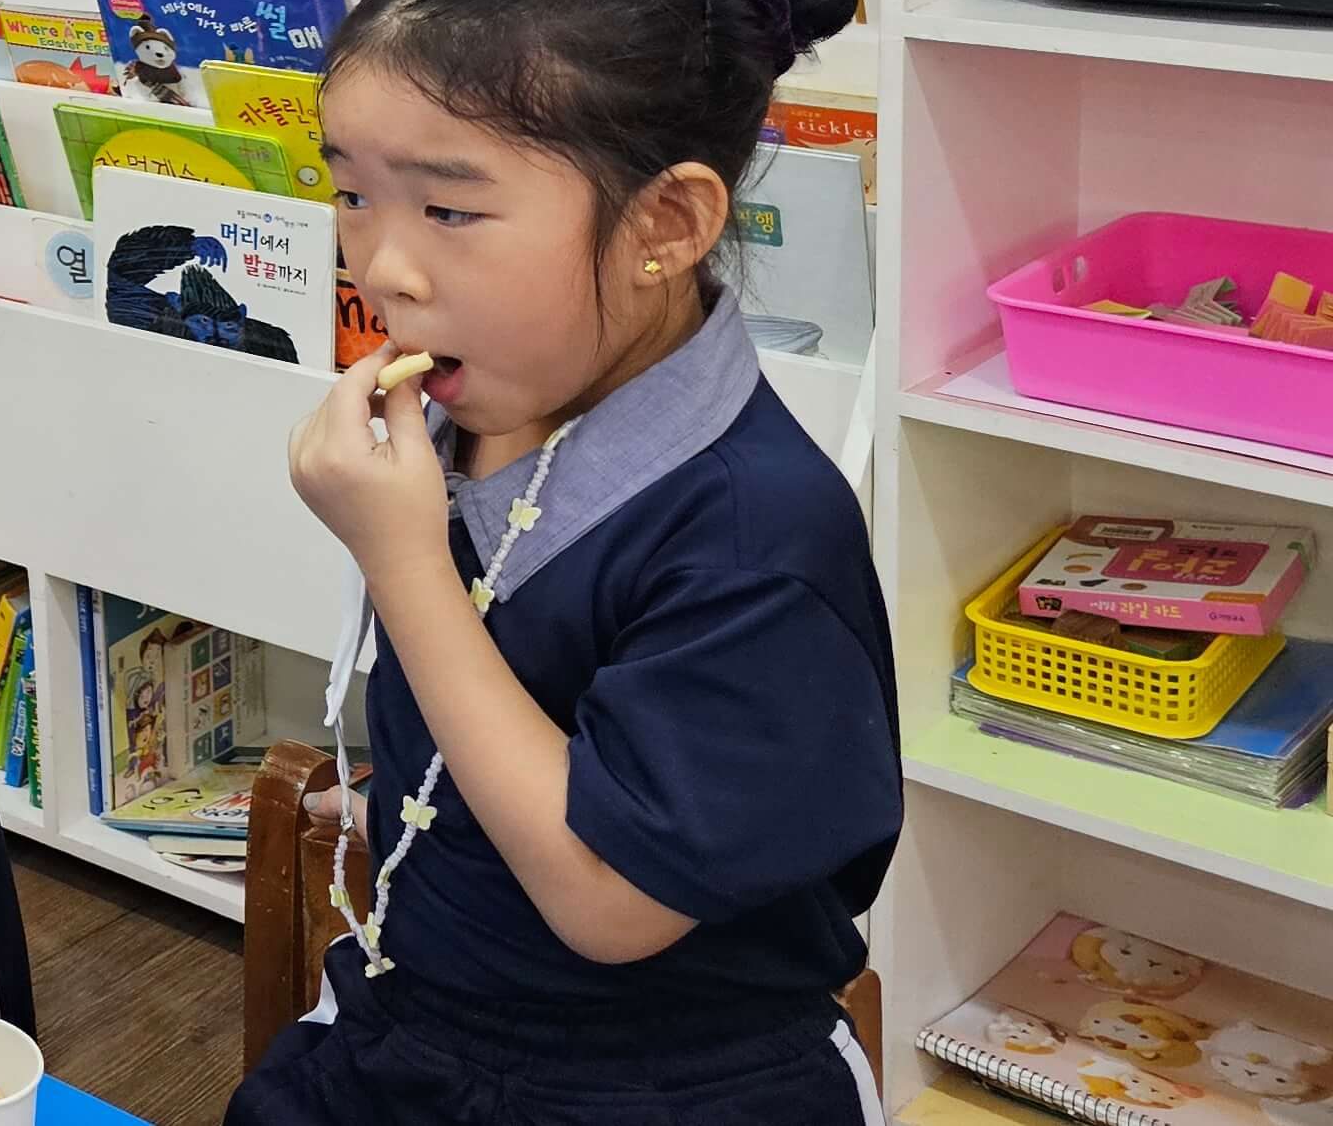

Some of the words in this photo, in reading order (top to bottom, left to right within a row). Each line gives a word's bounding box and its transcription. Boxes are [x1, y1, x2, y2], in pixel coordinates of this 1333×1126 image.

[160, 0, 217, 19] 세상에서
[195, 16, 226, 37] 가장
[229, 16, 259, 35] 빠른
[254, 0, 324, 50] 썰매
[5, 18, 59, 38] Where
[63, 20, 95, 41] Are
[36, 36, 83, 52] Easter
[237, 96, 318, 127] 카롤린
[220, 223, 290, 256] 머리에서
[243, 253, 308, 286] 발끝까지
